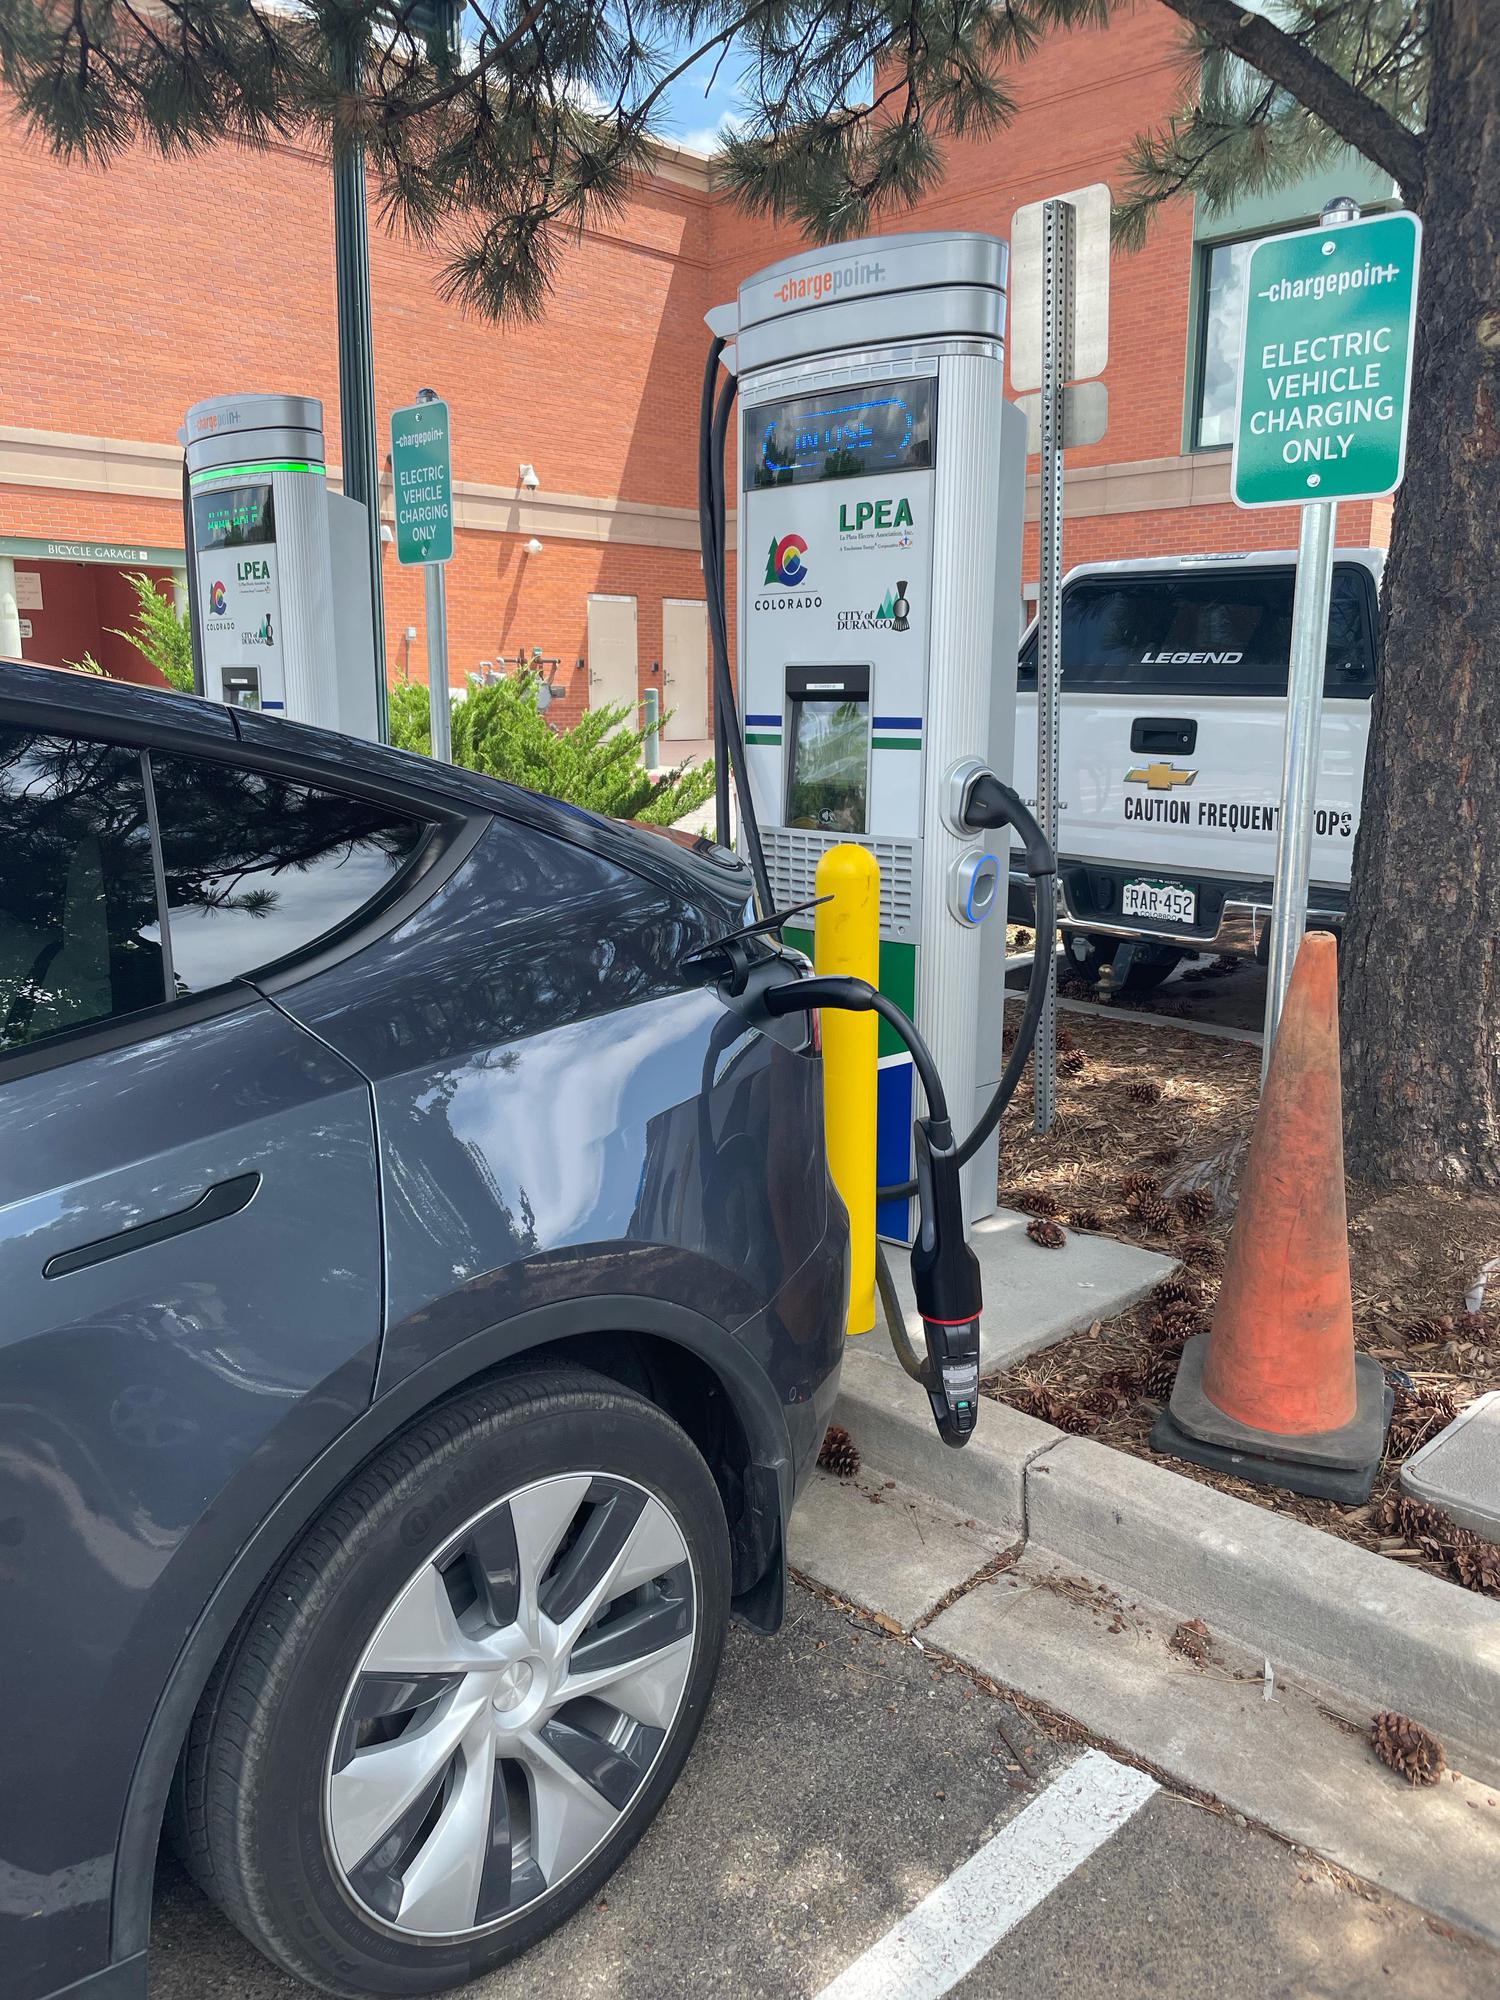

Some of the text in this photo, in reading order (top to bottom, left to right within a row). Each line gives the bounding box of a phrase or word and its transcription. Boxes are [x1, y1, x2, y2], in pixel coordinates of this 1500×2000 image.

[1257, 262, 1399, 302] chargepoint
[1261, 327, 1392, 370] ELECTRIC
[1267, 363, 1381, 401] VEHICLE
[1250, 396, 1394, 435] CHARGING
[1282, 433, 1356, 464] ONLY
[400, 464, 444, 486] ELECTRIC
[403, 484, 443, 502] VEHICLE
[399, 503, 448, 525] CHARGING
[839, 498, 914, 532] LPEA
[412, 525, 437, 542] ONLY
[48, 544, 137, 560] BICYCLE GARAGE
[237, 560, 271, 581] LPEA
[754, 596, 823, 611] COLORADO
[207, 622, 235, 631] COLORADO
[837, 610, 874, 622] CITY of
[837, 619, 893, 631] DURANGO
[1141, 652, 1244, 665] LEGEND
[1124, 797, 1190, 824] CAUTION
[1313, 810, 1352, 837] OPS
[1140, 910, 1176, 920] COLORADO
